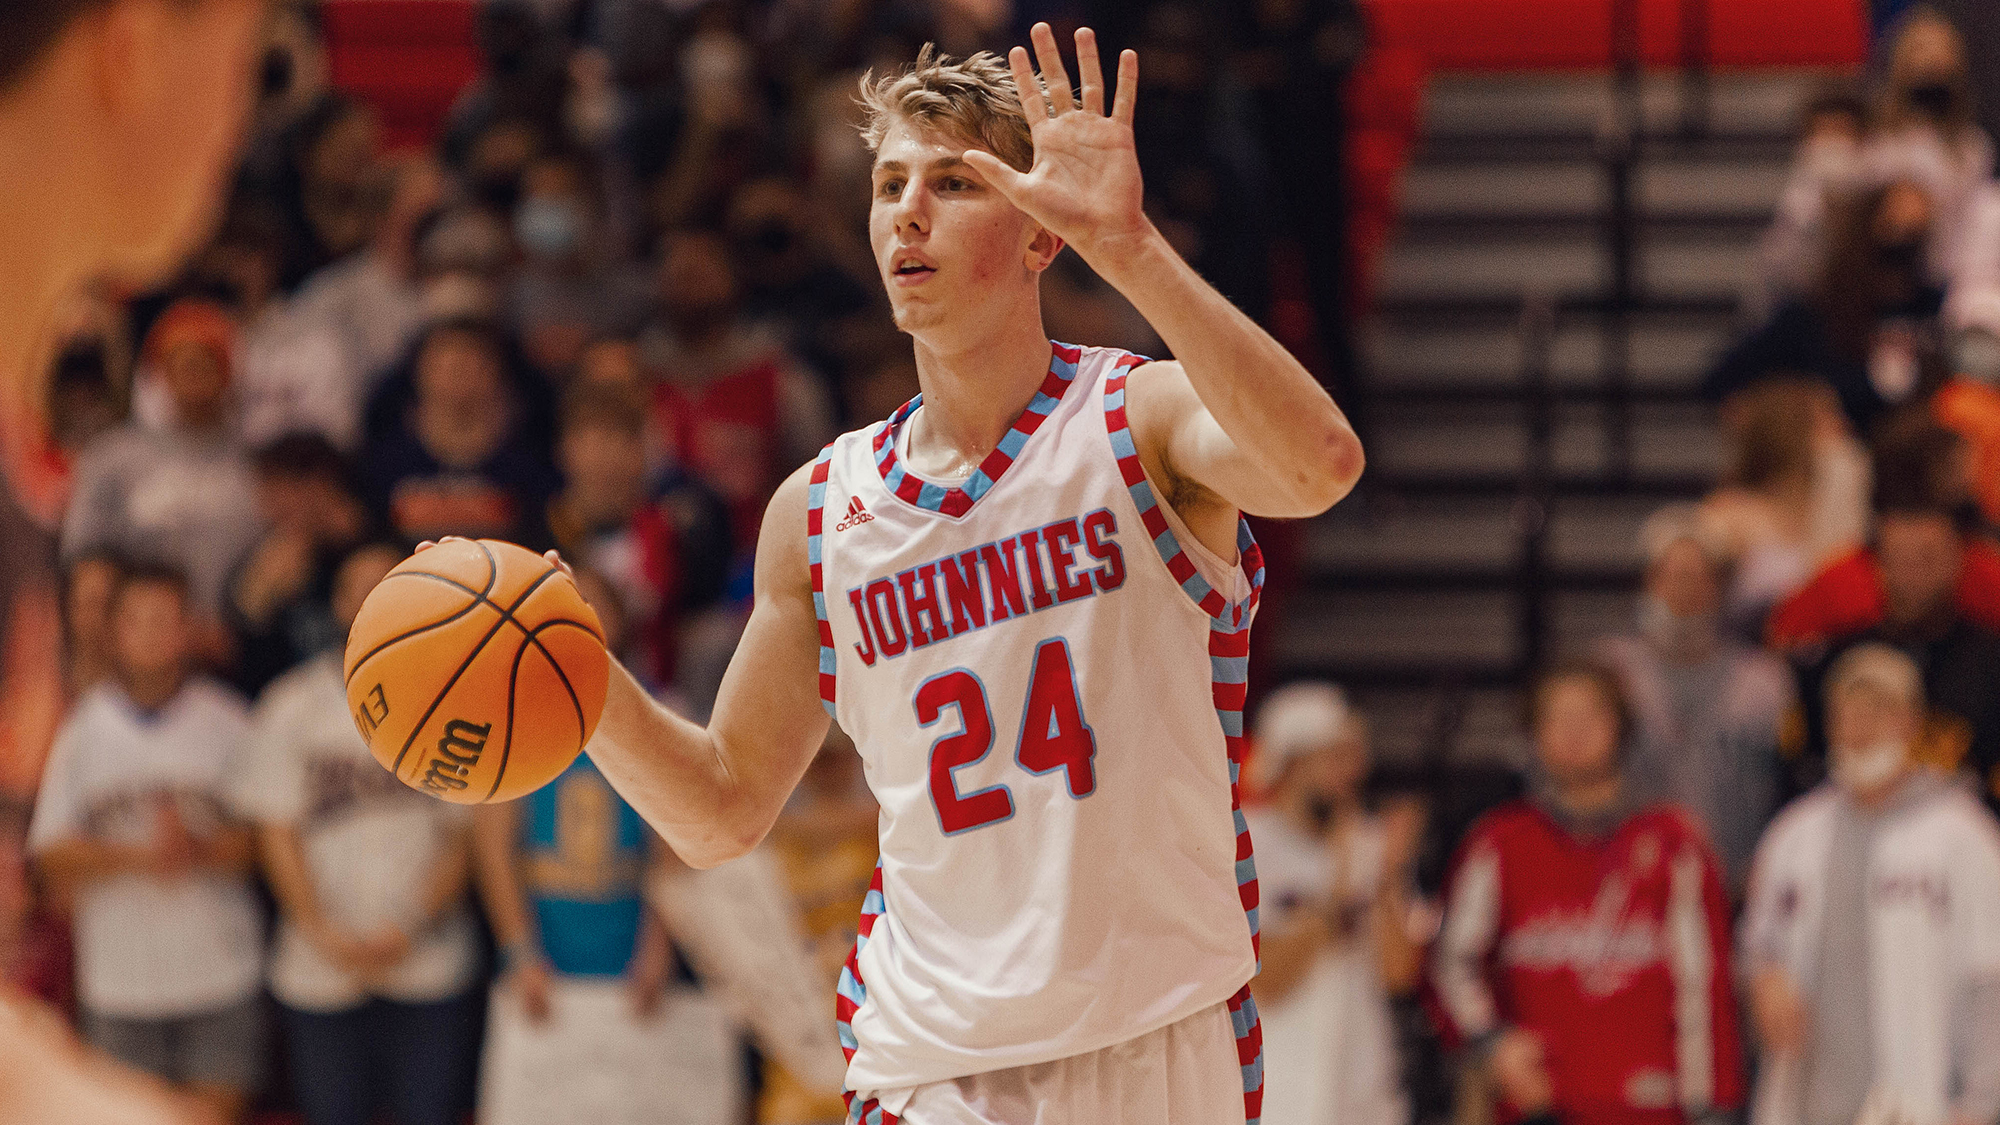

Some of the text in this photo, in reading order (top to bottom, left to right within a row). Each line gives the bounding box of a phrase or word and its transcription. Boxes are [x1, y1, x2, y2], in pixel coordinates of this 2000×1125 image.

[836, 511, 875, 532] adidas
[847, 507, 1127, 667] JOHNNIES
[912, 636, 1097, 837] 24
